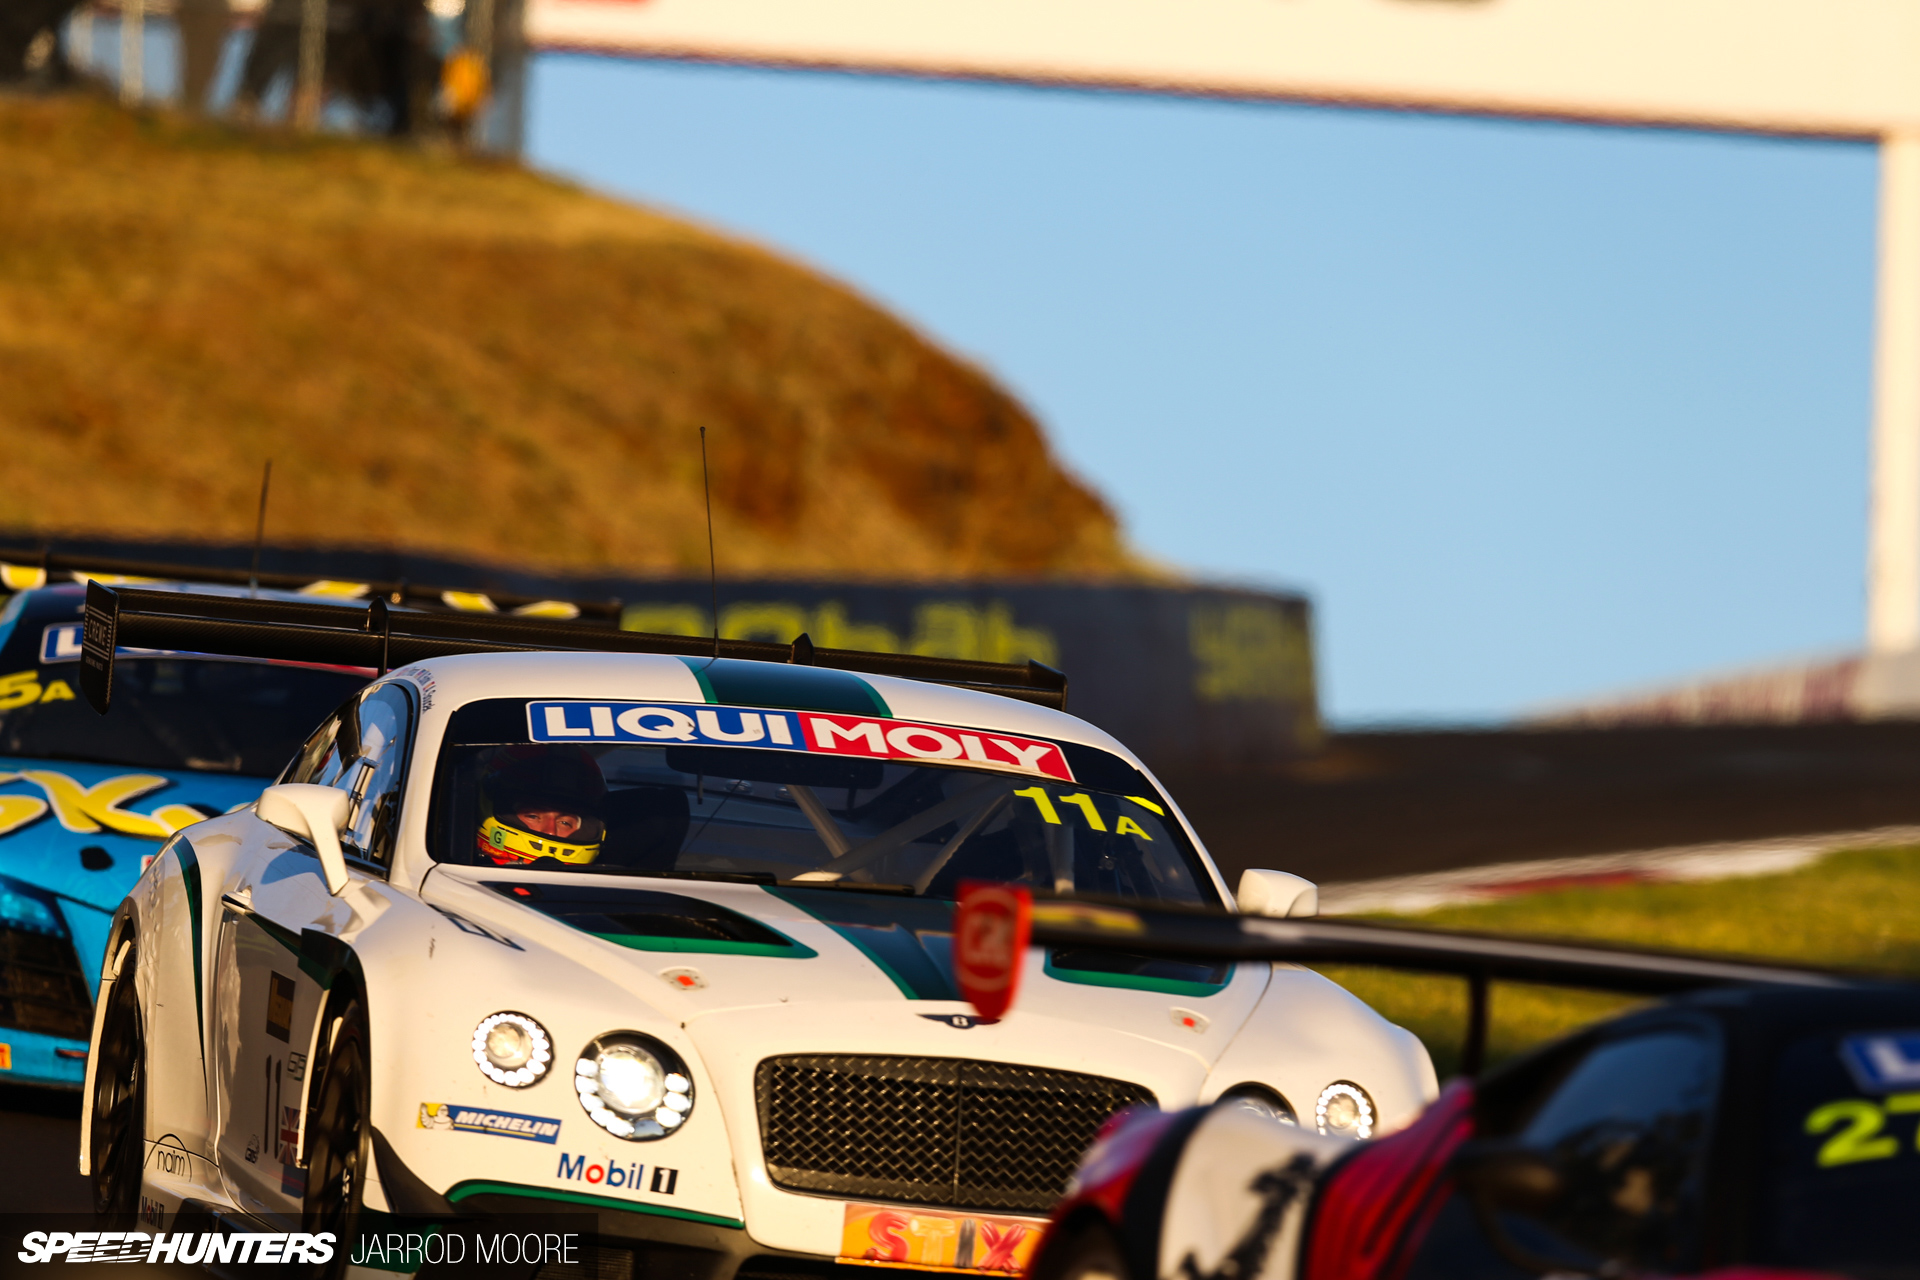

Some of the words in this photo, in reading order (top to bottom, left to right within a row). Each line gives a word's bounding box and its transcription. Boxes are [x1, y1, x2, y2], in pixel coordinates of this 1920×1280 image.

[544, 706, 794, 746] LIQUI
[809, 717, 1052, 772] MOLY
[455, 1110, 559, 1137] MICHELIN
[157, 1149, 186, 1177] naim
[557, 1152, 644, 1190] Mobil
[655, 1167, 676, 1194] 1
[862, 1211, 1027, 1275] STIX
